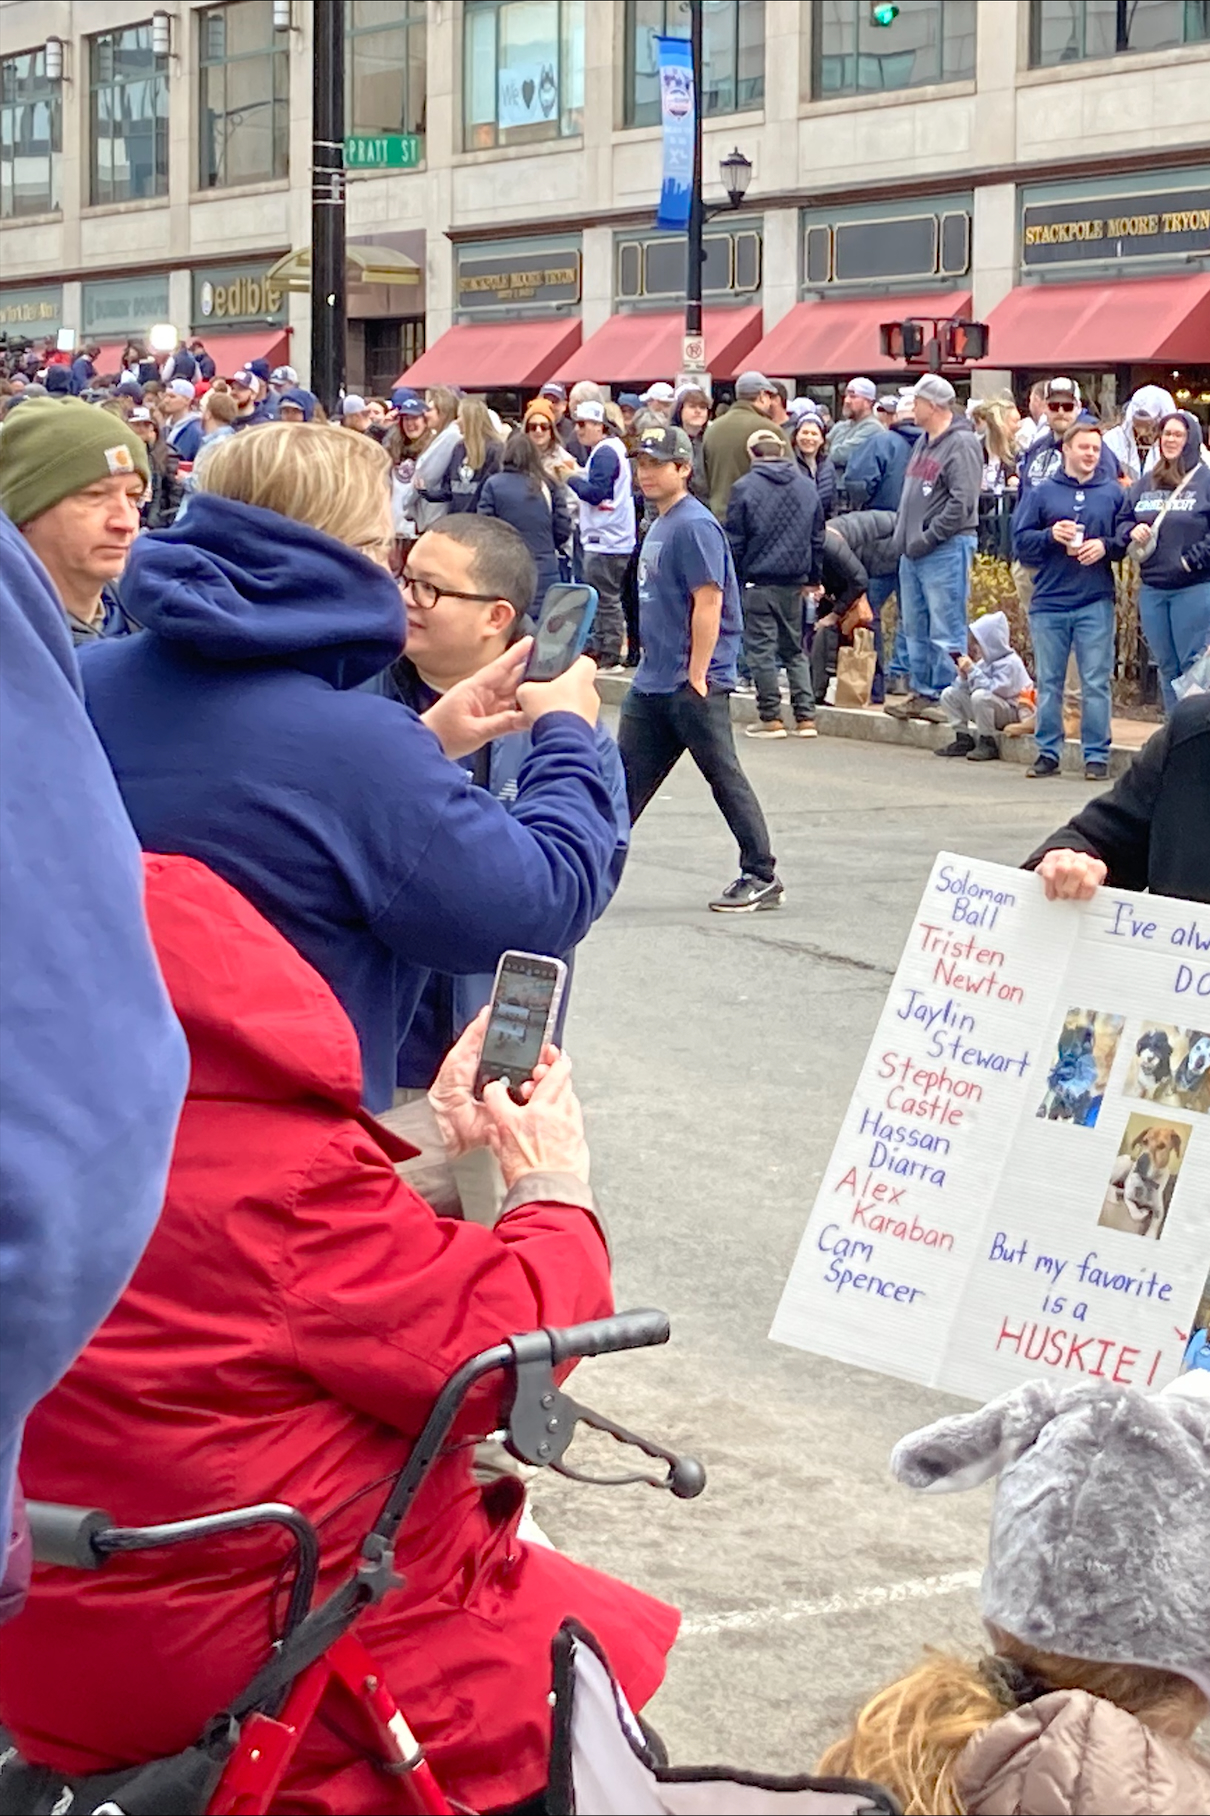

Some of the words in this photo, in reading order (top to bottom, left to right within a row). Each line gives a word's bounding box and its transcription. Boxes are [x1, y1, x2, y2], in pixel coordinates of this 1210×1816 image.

[349, 139, 388, 162] PRATT
[401, 139, 416, 162] ST
[1025, 220, 1103, 245] STACKPOLE
[1107, 213, 1158, 238] MOORE
[1162, 209, 1210, 233] TRYON
[215, 276, 282, 317] edible
[936, 864, 1016, 907] Soloman
[951, 897, 999, 930] Ball
[1104, 901, 1157, 939] I've
[919, 923, 1006, 967] Tristen
[932, 958, 1025, 1004] Newton
[897, 988, 976, 1034] Jaylin
[926, 1029, 1031, 1078] Stewart
[877, 1051, 983, 1102] Stephon
[886, 1085, 965, 1127] Castle
[858, 1107, 951, 1155] Hassan
[834, 1165, 907, 1206] Alex
[867, 1140, 947, 1188] Diarra
[817, 1223, 874, 1263] Cam
[851, 1201, 955, 1252] Karaban
[823, 1258, 927, 1305] Spencer
[988, 1232, 1029, 1265] But
[1034, 1254, 1069, 1282] my
[1076, 1251, 1174, 1302] favorite
[1042, 1288, 1068, 1315] is
[1072, 1301, 1089, 1322] a
